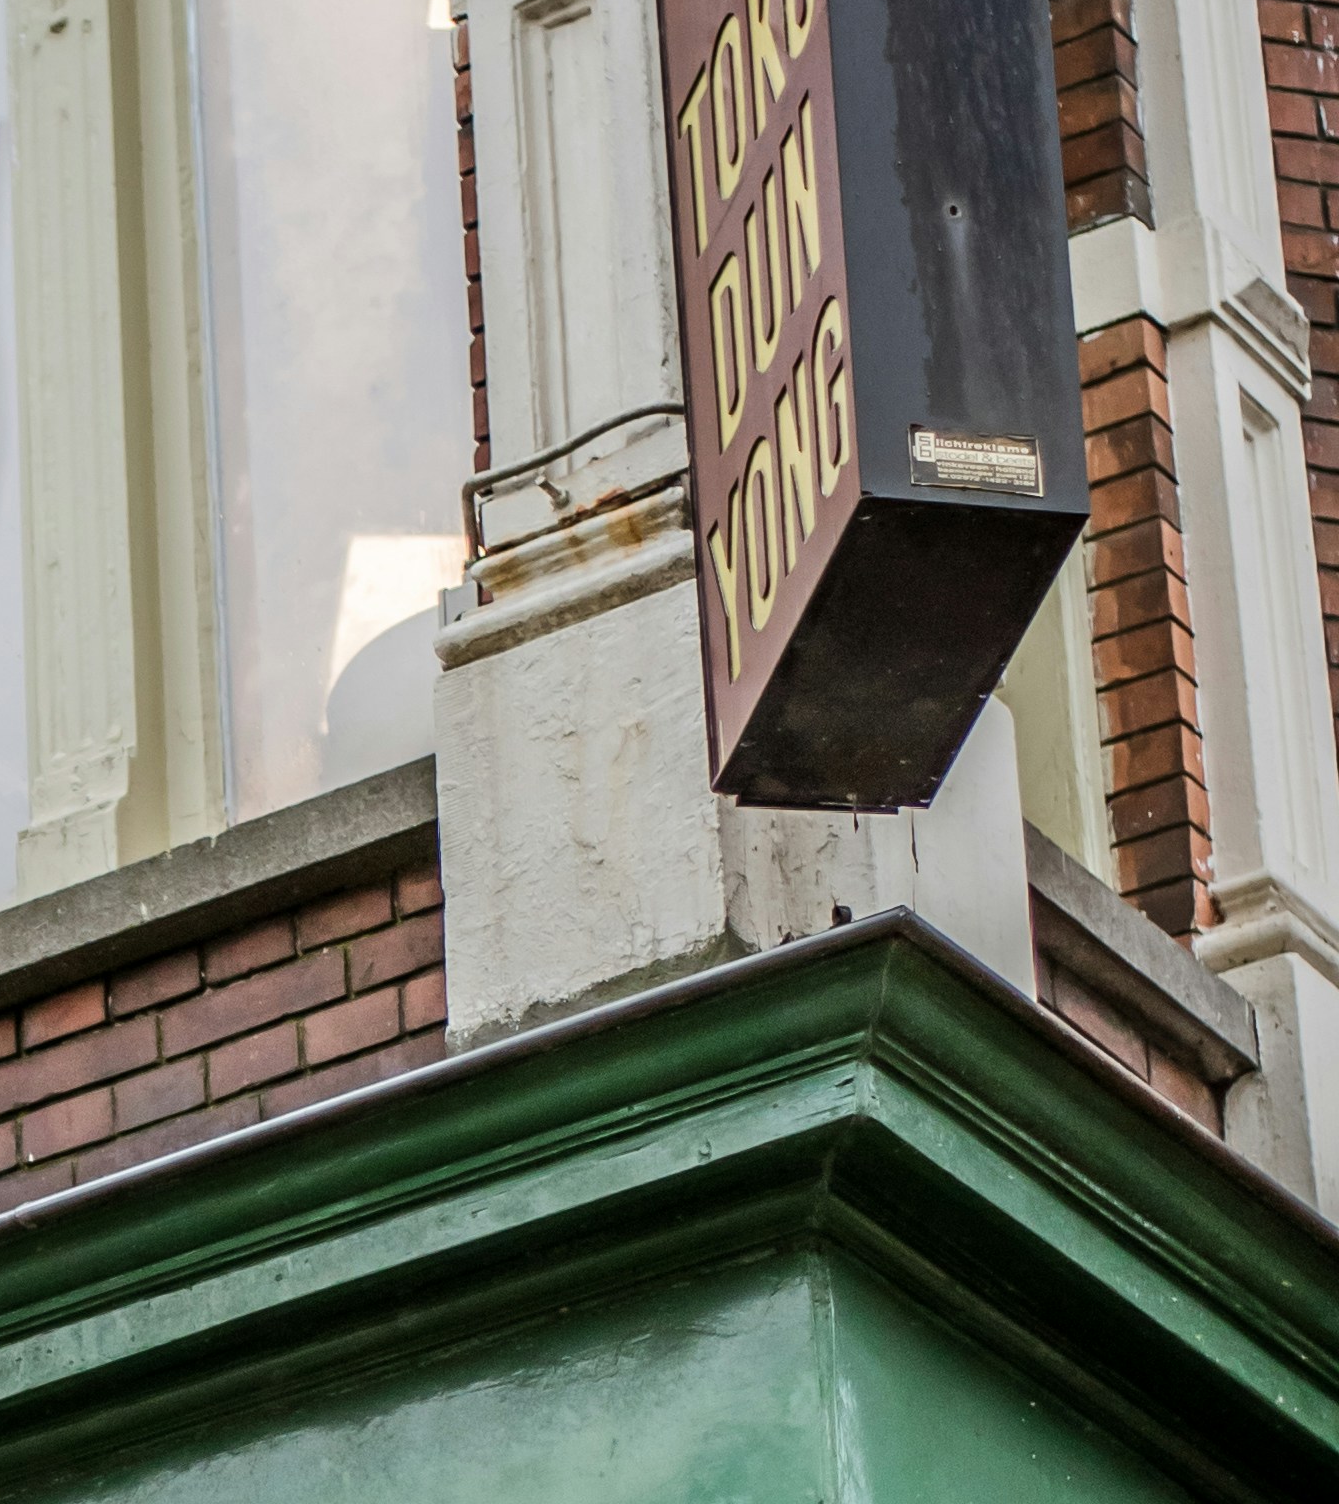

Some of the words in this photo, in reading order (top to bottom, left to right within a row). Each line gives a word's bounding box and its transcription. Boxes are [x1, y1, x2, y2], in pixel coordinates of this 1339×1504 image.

[708, 93, 821, 454] DUN
[935, 438, 1030, 454] lichtreklame
[707, 294, 849, 683] YONG
